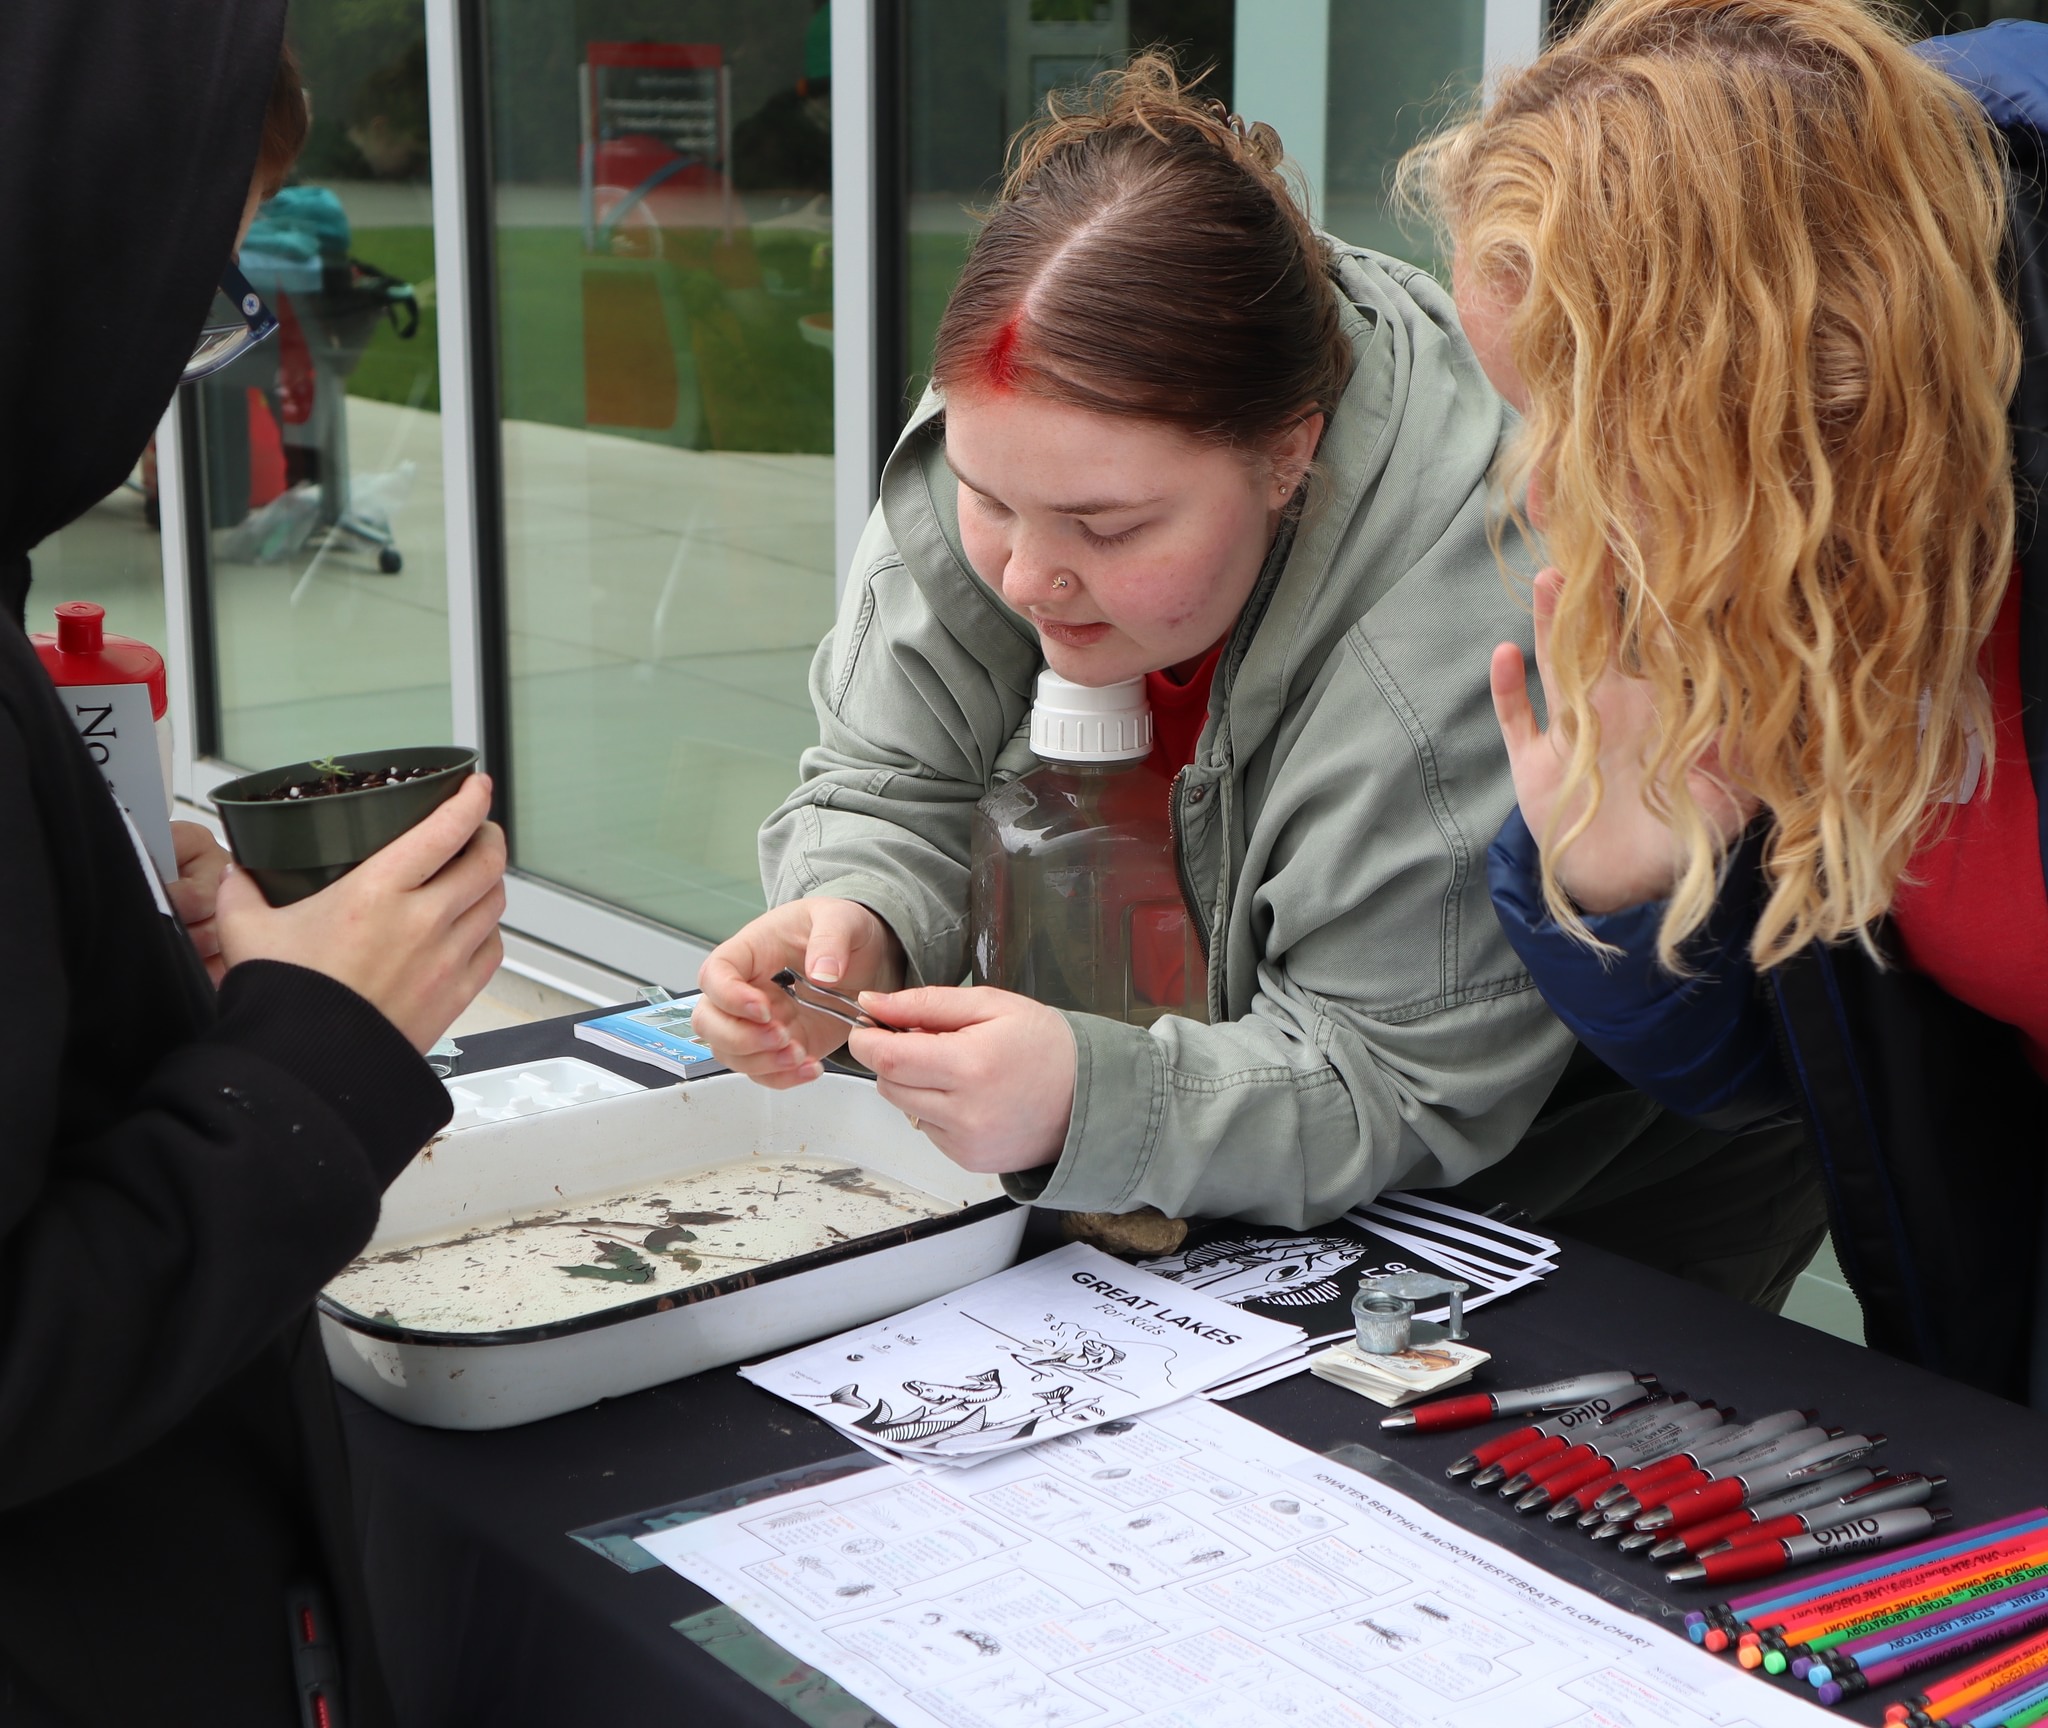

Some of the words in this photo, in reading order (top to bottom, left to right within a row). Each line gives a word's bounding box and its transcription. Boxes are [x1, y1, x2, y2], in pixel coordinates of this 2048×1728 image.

[1071, 1271, 1159, 1310] GREAT
[1153, 1308, 1242, 1346] LAKES
[1092, 1303, 1127, 1318] For
[1122, 1317, 1166, 1335] Kids
[1558, 1398, 1610, 1427] OHIO
[1644, 1421, 1677, 1440] GRANT
[1811, 1519, 1879, 1544] OHIO
[1817, 1544, 1839, 1555] SEA
[1842, 1535, 1882, 1550] GRANT
[1313, 1472, 1369, 1502] IOWATER
[1366, 1499, 1421, 1533] BENTHIC
[1418, 1532, 1563, 1608] MACROINVERTEBRATE
[1561, 1605, 1606, 1627] FLOW
[1601, 1625, 1655, 1649] CHART
[1947, 1577, 1982, 1595] GRANT
[1981, 1570, 2003, 1584] SEA
[2003, 1570, 2026, 1586] SEA
[1968, 1578, 2004, 1598] GRANT
[1894, 1594, 1930, 1612] STONE
[1916, 1594, 1955, 1615] STONE
[2010, 1589, 2046, 1608] GRANT
[1823, 1605, 1893, 1635] LABORATORY
[1846, 1607, 1917, 1638] LABORATORY
[1960, 1606, 1996, 1625] STONE
[1887, 1618, 1958, 1651] LABORATORY
